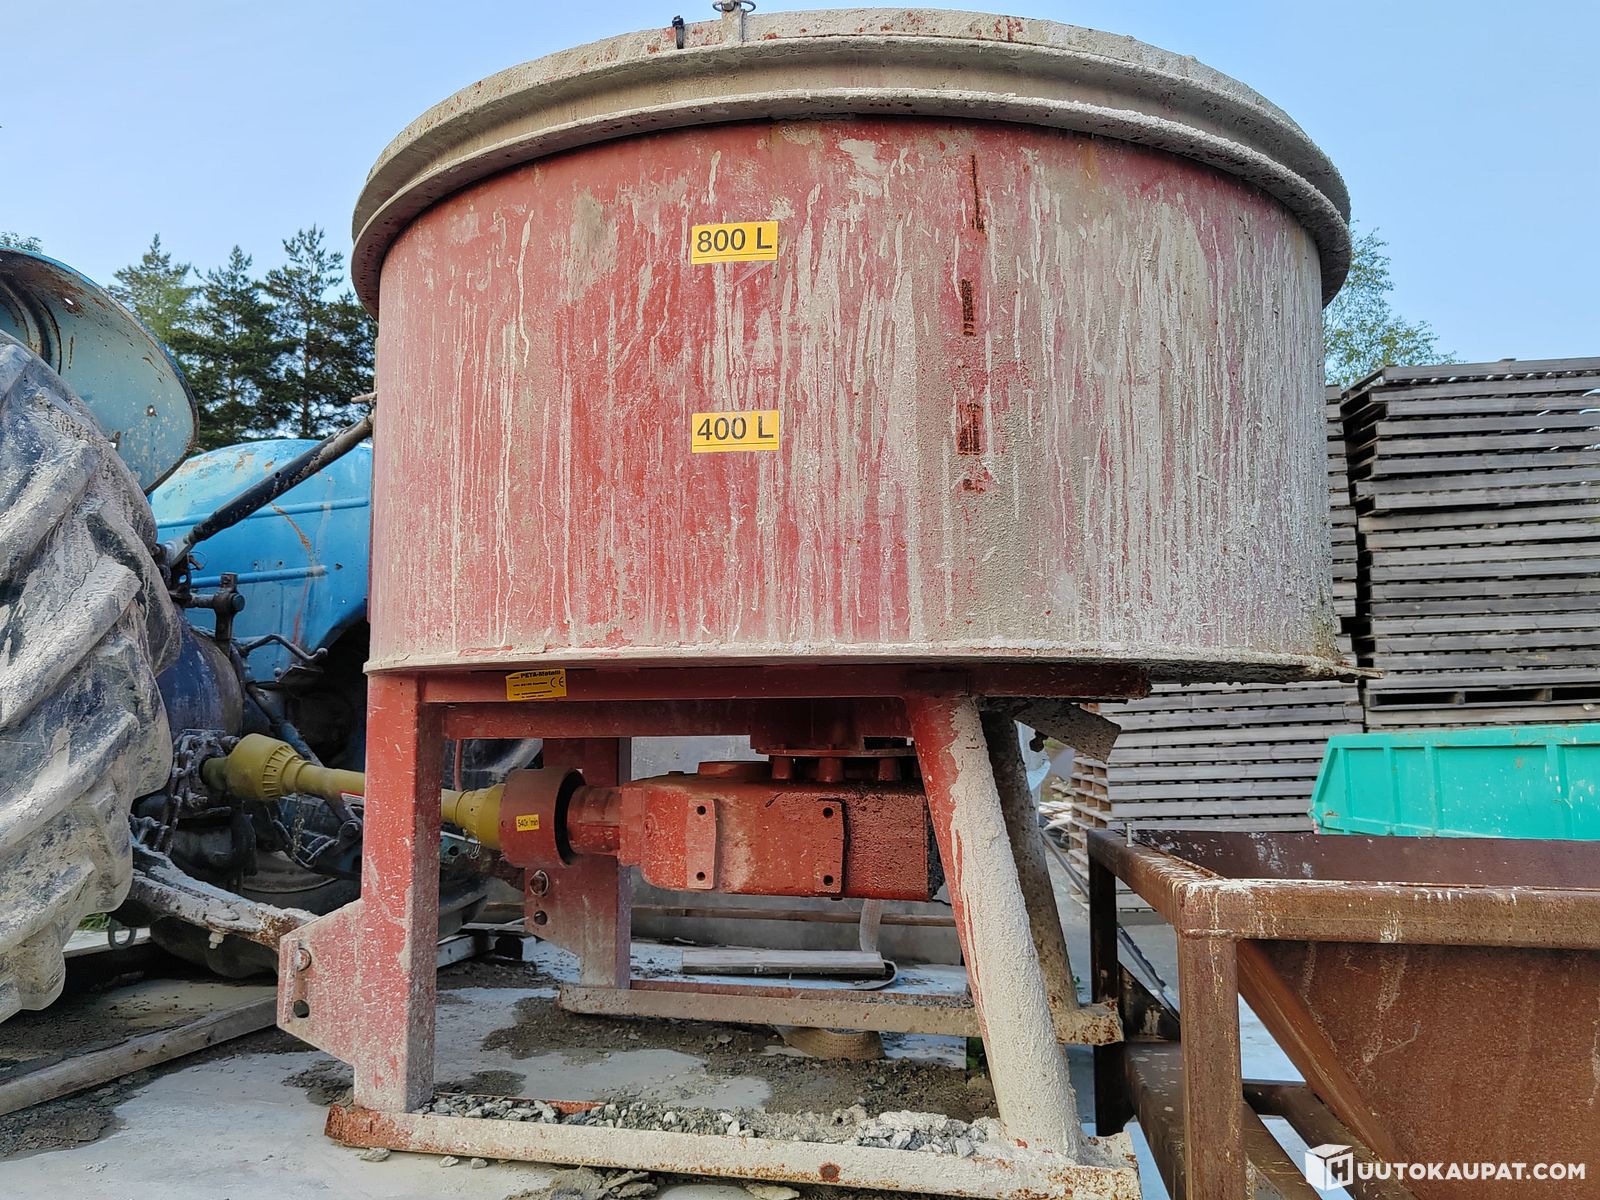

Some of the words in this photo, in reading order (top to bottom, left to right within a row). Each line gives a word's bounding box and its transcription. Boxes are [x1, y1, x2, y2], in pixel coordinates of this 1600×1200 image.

[697, 228, 746, 253] 800
[756, 226, 773, 250] L
[697, 416, 747, 441] 400
[757, 415, 774, 439] L
